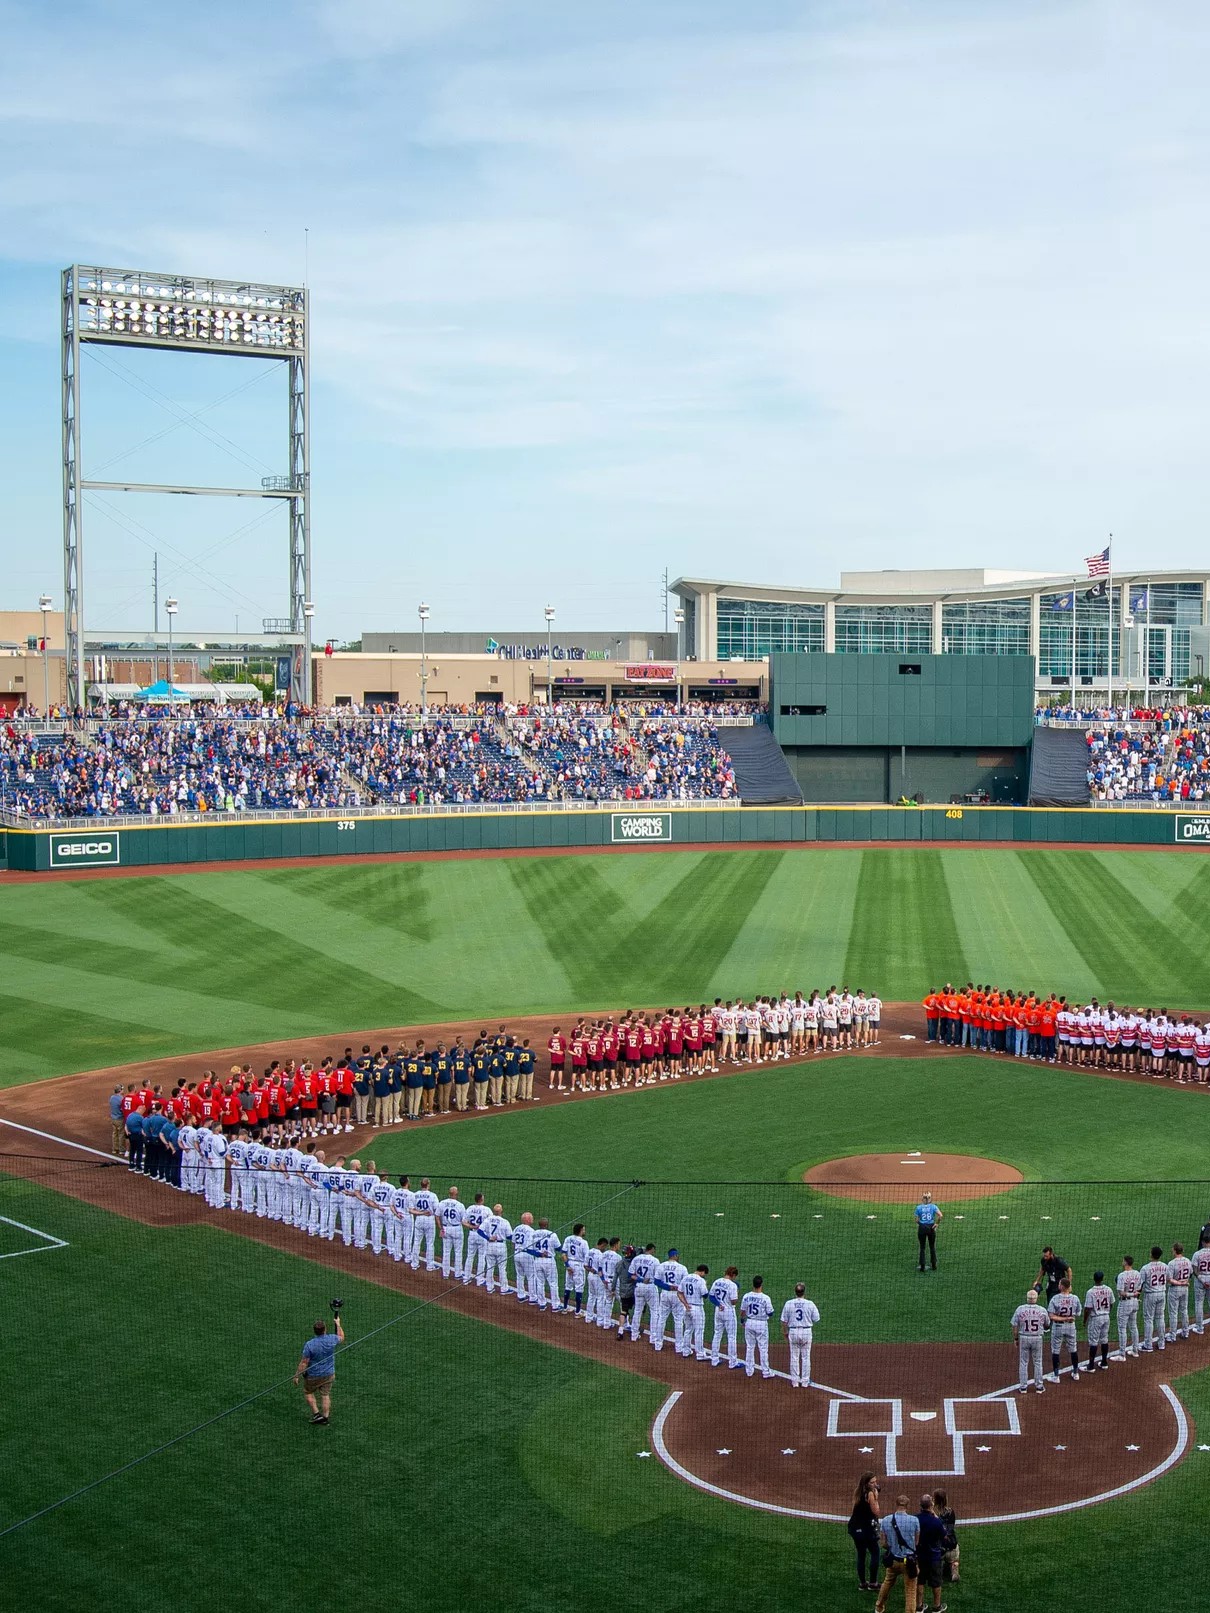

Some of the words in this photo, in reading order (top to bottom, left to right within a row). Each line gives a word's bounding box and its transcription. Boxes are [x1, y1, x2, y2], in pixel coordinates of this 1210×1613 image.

[552, 645, 585, 660] Center
[946, 810, 963, 818] 408
[337, 820, 356, 830] 375
[620, 818, 663, 827] CAMPING
[621, 826, 663, 837] WORLD
[57, 842, 112, 856] GEICO
[408, 1064, 418, 1073] 29
[182, 1134, 187, 1143] 4
[230, 1148, 240, 1159] 26
[258, 1155, 268, 1165] 43
[345, 1179, 354, 1189] 61
[363, 1182, 372, 1192] 17
[375, 1192, 387, 1202] 57
[395, 1198, 404, 1208] 31
[416, 1200, 429, 1210] 40
[444, 1209, 456, 1219] 46
[470, 1215, 482, 1225] 24
[491, 1224, 497, 1234] 7
[514, 1233, 524, 1244] 23
[535, 1240, 548, 1250] 44
[570, 1246, 576, 1256] 6
[637, 1266, 648, 1277] 47
[1178, 1269, 1189, 1280] 12
[664, 1272, 675, 1283] 12
[1151, 1274, 1166, 1286] 24
[685, 1284, 694, 1296] 19
[1129, 1282, 1135, 1293] 9
[715, 1288, 727, 1301] 27
[748, 1304, 759, 1315] 15
[1096, 1298, 1109, 1311] 14
[795, 1309, 803, 1321] 3
[1060, 1307, 1072, 1317] 21
[1024, 1320, 1039, 1332] 15
